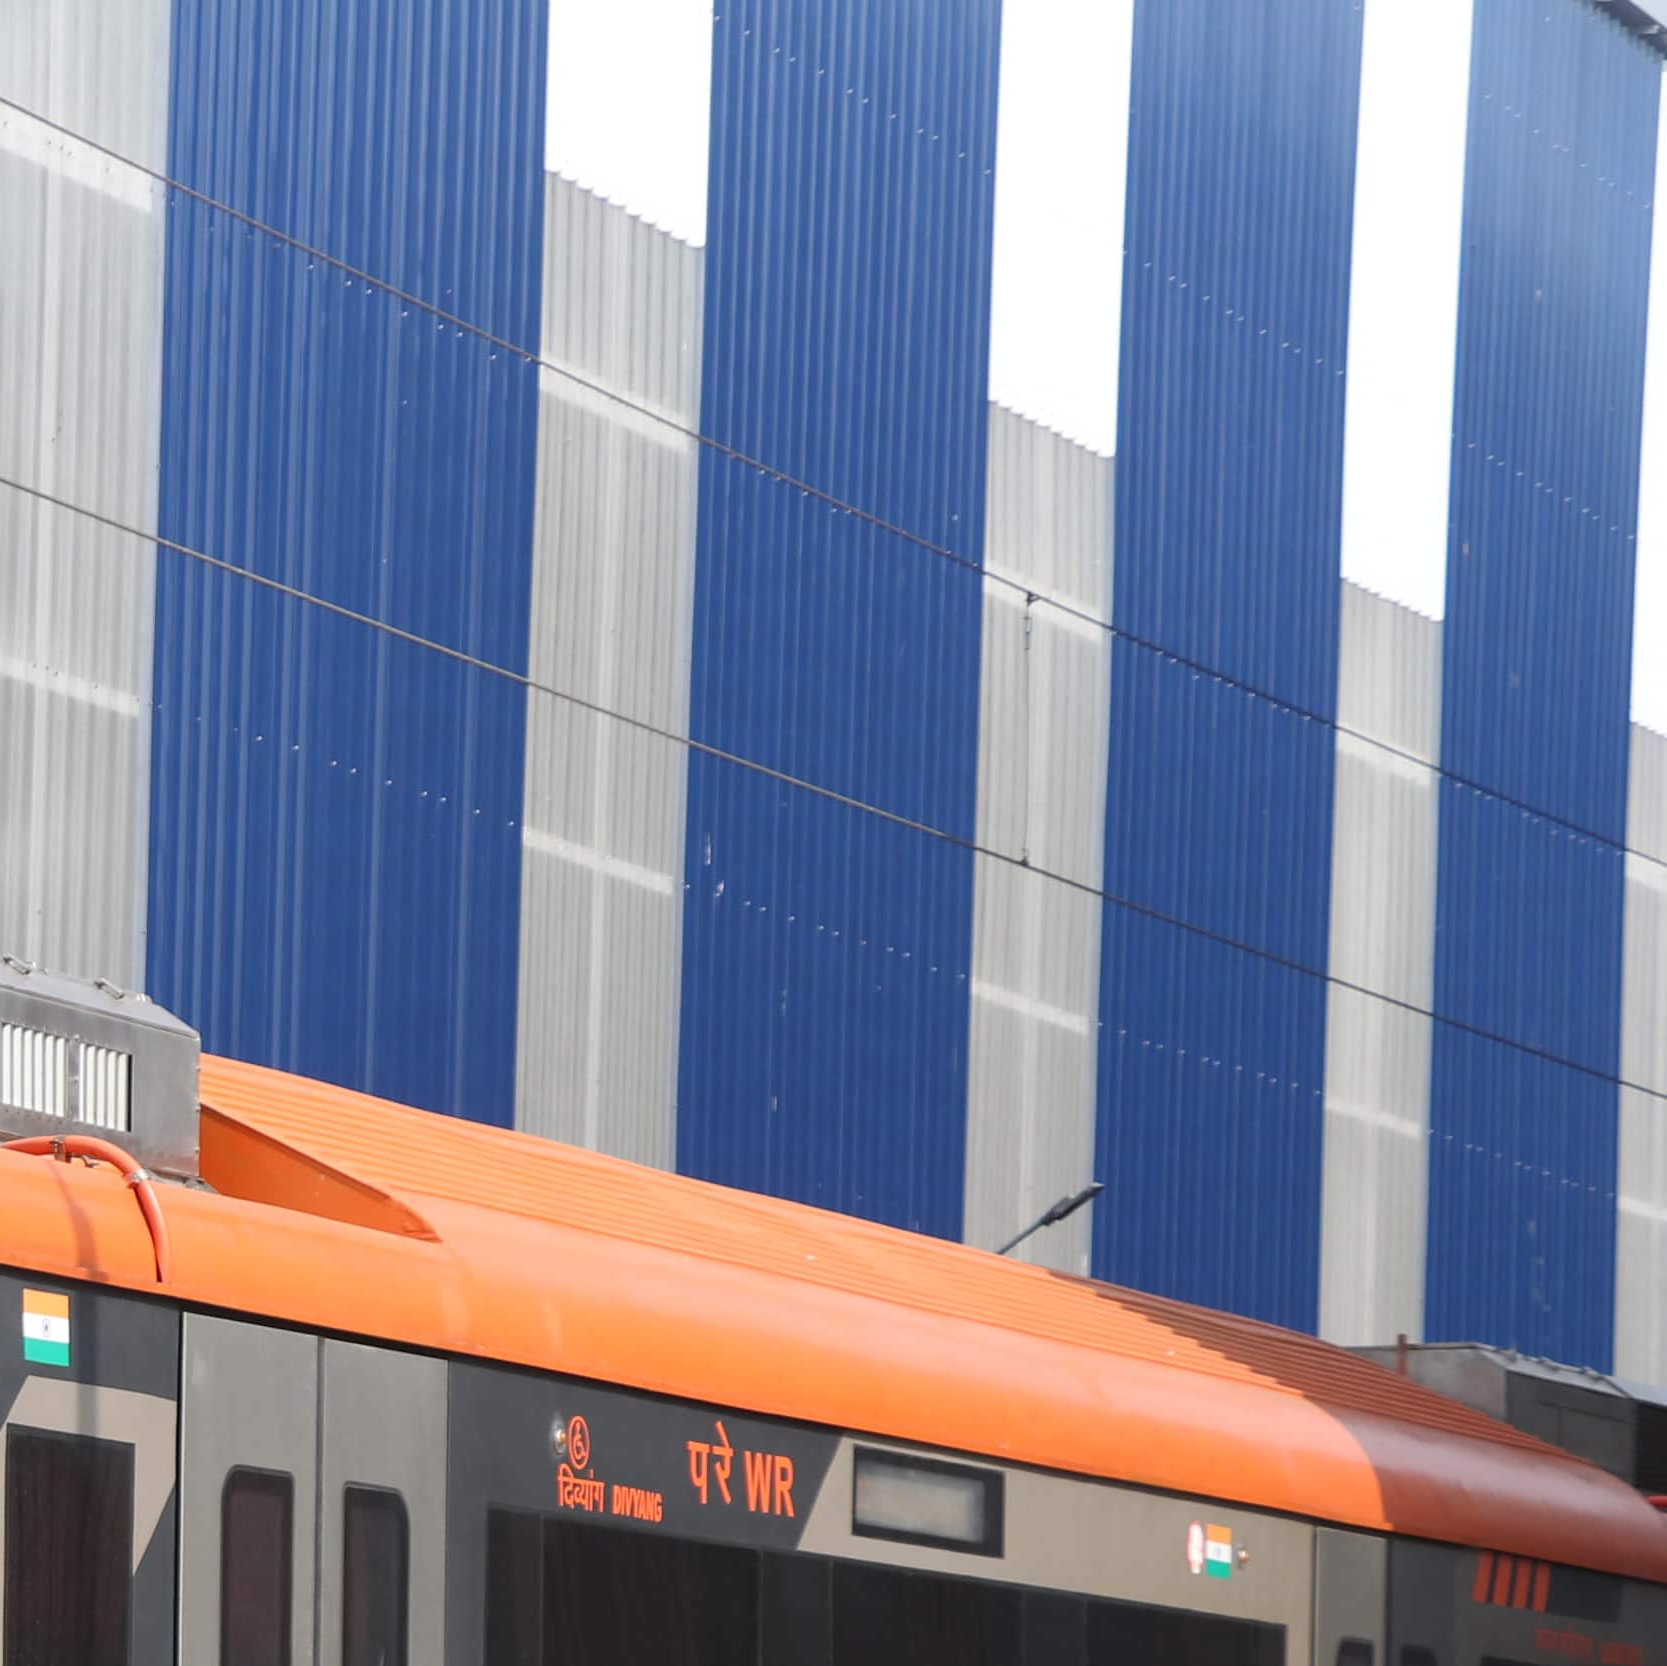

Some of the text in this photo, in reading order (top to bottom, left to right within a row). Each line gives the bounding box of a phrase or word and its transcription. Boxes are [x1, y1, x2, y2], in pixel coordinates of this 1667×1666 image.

[557, 1463, 605, 1512] दिव्यांग
[612, 1484, 663, 1522] DIVYANG
[744, 1450, 795, 1517] WR
